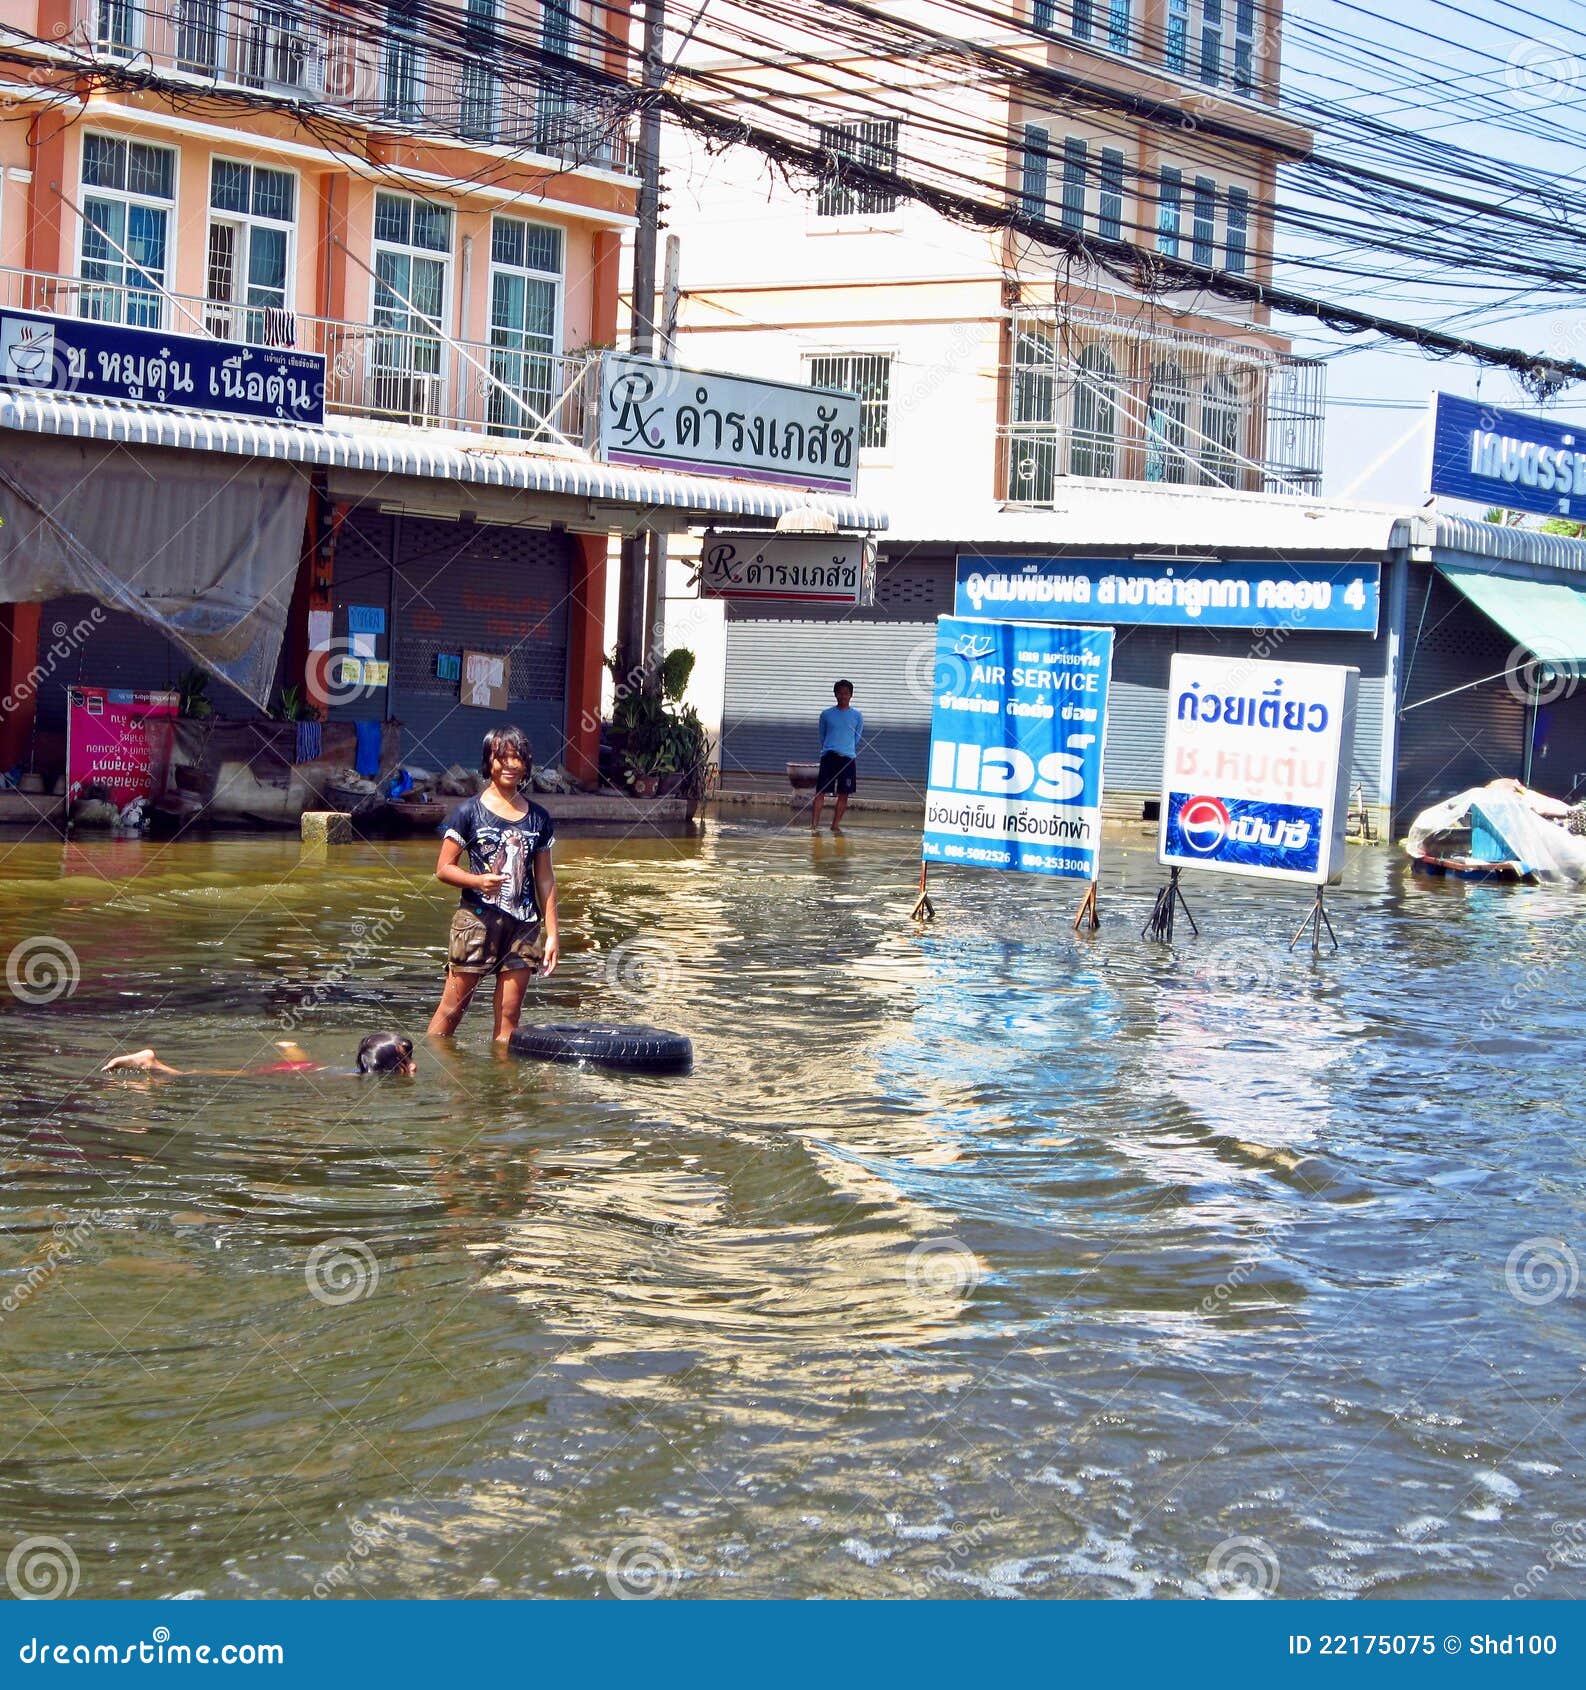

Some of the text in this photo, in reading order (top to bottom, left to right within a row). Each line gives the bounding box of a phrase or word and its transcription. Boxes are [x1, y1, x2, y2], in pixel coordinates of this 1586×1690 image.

[209, 348, 311, 417] เนื้อตุ๋น
[675, 387, 854, 469] ดำรงเภสัช
[746, 555, 857, 587] ดำรงเภสัช
[1257, 579, 1332, 610] คลอง
[1343, 578, 1367, 611] 4
[970, 666, 1100, 693] AIR SERVICE
[1177, 678, 1329, 733] ก๋วยเตี๋ยว
[931, 733, 1096, 801] แอร์
[928, 801, 1091, 840] ซ่อมตู้เย็น เครื่องซักผ้า
